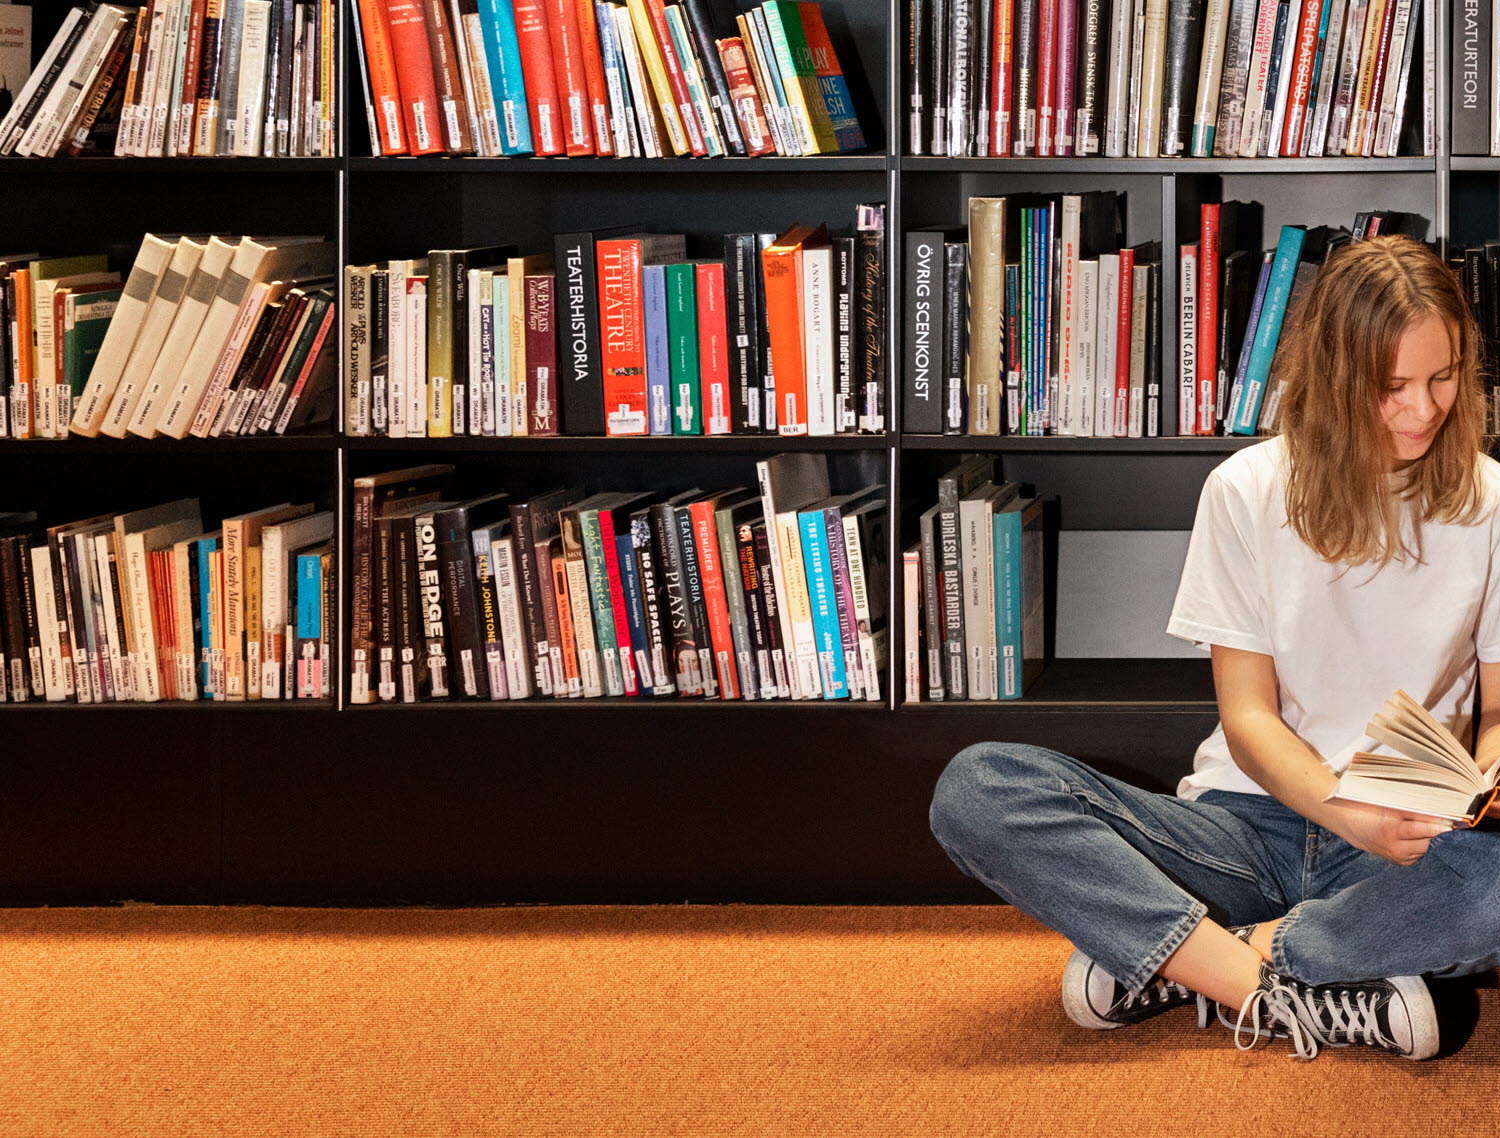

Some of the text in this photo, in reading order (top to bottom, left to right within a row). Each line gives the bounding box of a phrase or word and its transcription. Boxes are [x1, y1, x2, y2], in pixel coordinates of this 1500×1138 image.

[803, 47, 829, 69] PLAY
[1087, 52, 1096, 88] SVENSK
[1292, 1, 1320, 99] SPELPLATSENS
[84, 78, 114, 128] GENERATION
[800, 77, 840, 96] IRVINE
[811, 96, 846, 117] WELSH
[390, 273, 403, 327] SVEABORG
[456, 264, 464, 301] Oscar Wilde
[604, 249, 624, 353] THEATRE
[863, 254, 880, 332] History of the
[350, 276, 359, 398] WESKER ARNOLD WESKER
[567, 246, 588, 380] TEATERHISTORIA
[625, 309, 634, 352] CENTURY
[915, 245, 932, 400] ÖVRIG SCENKONST
[1184, 297, 1194, 339] BERLIN
[839, 294, 850, 399] playing underground
[85, 396, 98, 423] DRAMATIK
[279, 402, 294, 428] DRAMATIK
[681, 515, 700, 602] TEATERHISTORIA
[699, 521, 712, 571] PREMIÄRER
[828, 534, 840, 570] HISTORY
[847, 527, 856, 546] TENN
[226, 527, 238, 636] More Stately Mansions
[421, 525, 442, 637] ON EDGE
[448, 561, 460, 616] PERFORMANCE
[456, 560, 465, 588] DIGITAL
[498, 548, 510, 587] MARTIN ESSLIN
[746, 546, 757, 589] REWRITING
[808, 523, 828, 616] THE LIVING THEATRE
[851, 560, 860, 573] ONE
[942, 513, 960, 628] BURLESKA BASTARDER
[479, 556, 495, 643] KEITH JOHNSTONE
[642, 552, 661, 649] NO SAFE SPACES
[666, 571, 686, 629] PLAYS
[853, 576, 865, 609] HUNDRED
